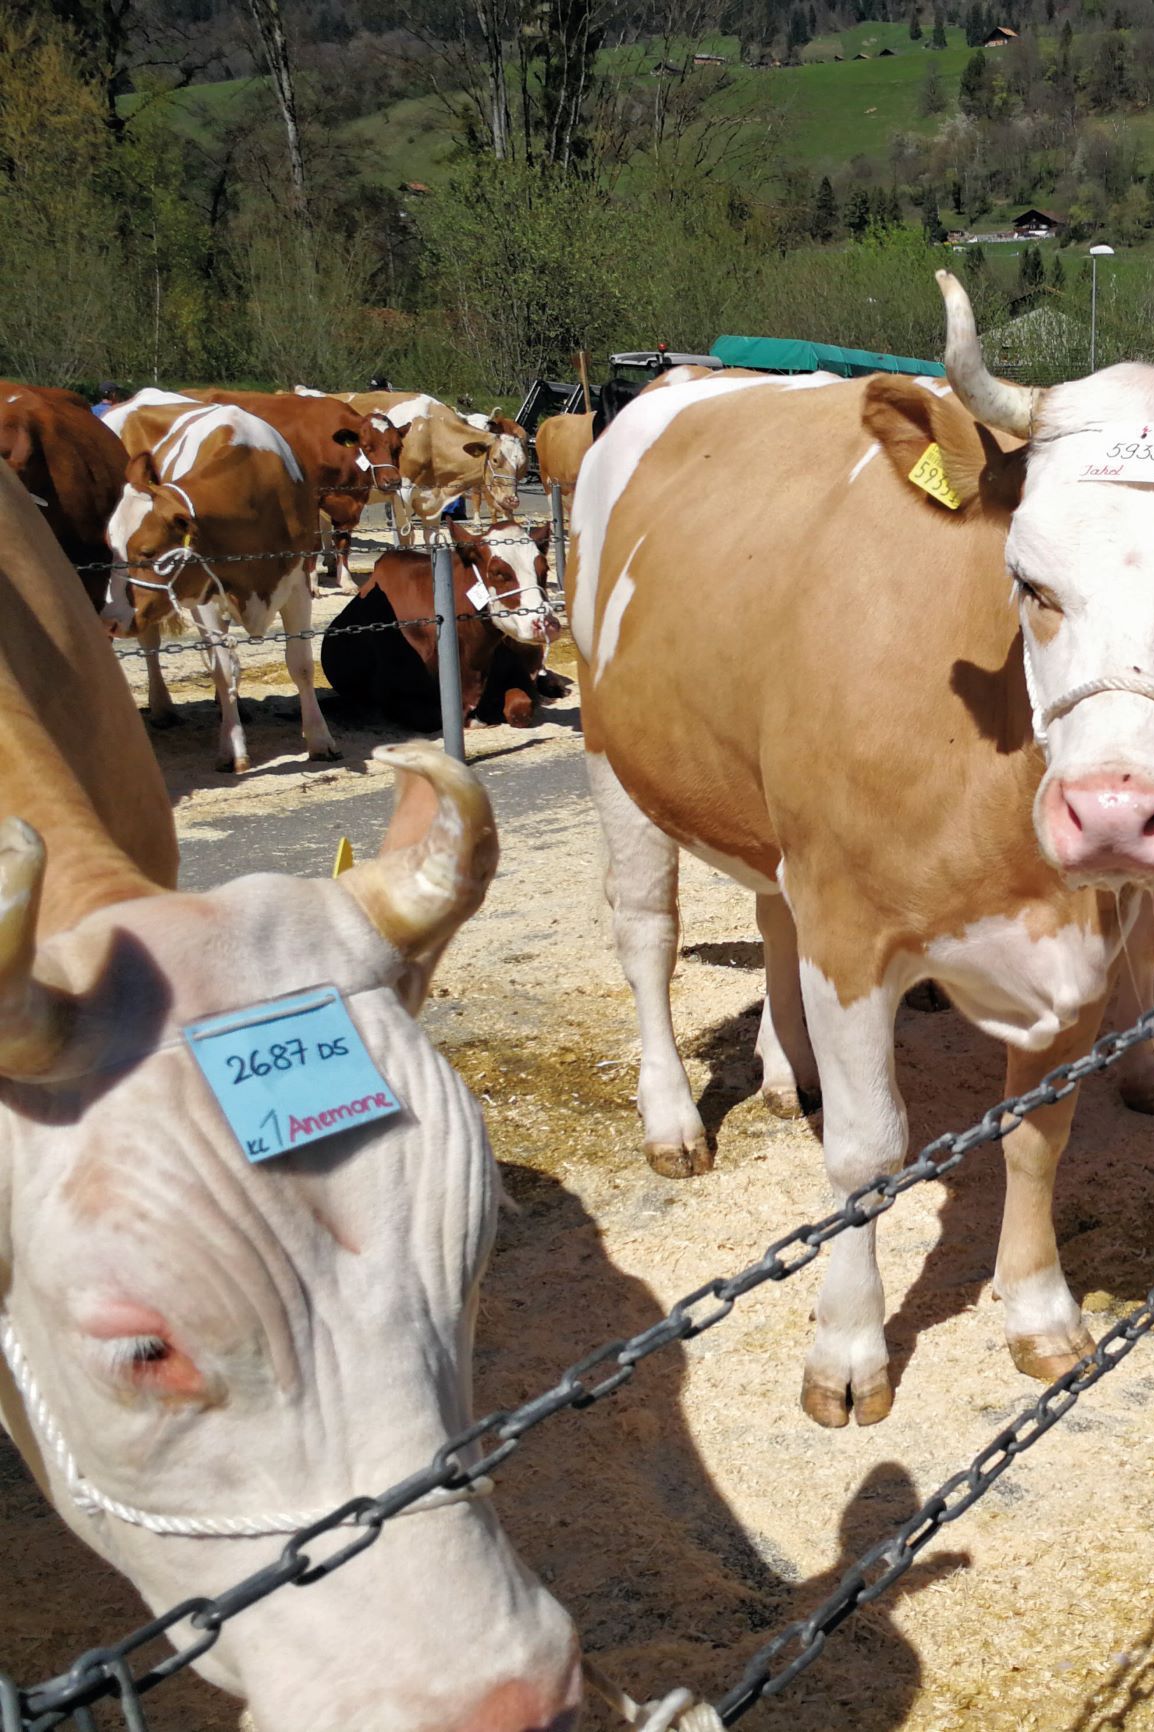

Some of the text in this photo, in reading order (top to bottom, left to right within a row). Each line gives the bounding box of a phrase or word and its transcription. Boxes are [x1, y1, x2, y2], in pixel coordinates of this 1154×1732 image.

[226, 1037, 349, 1085] 2687 DS
[288, 1092, 394, 1143] Anemone
